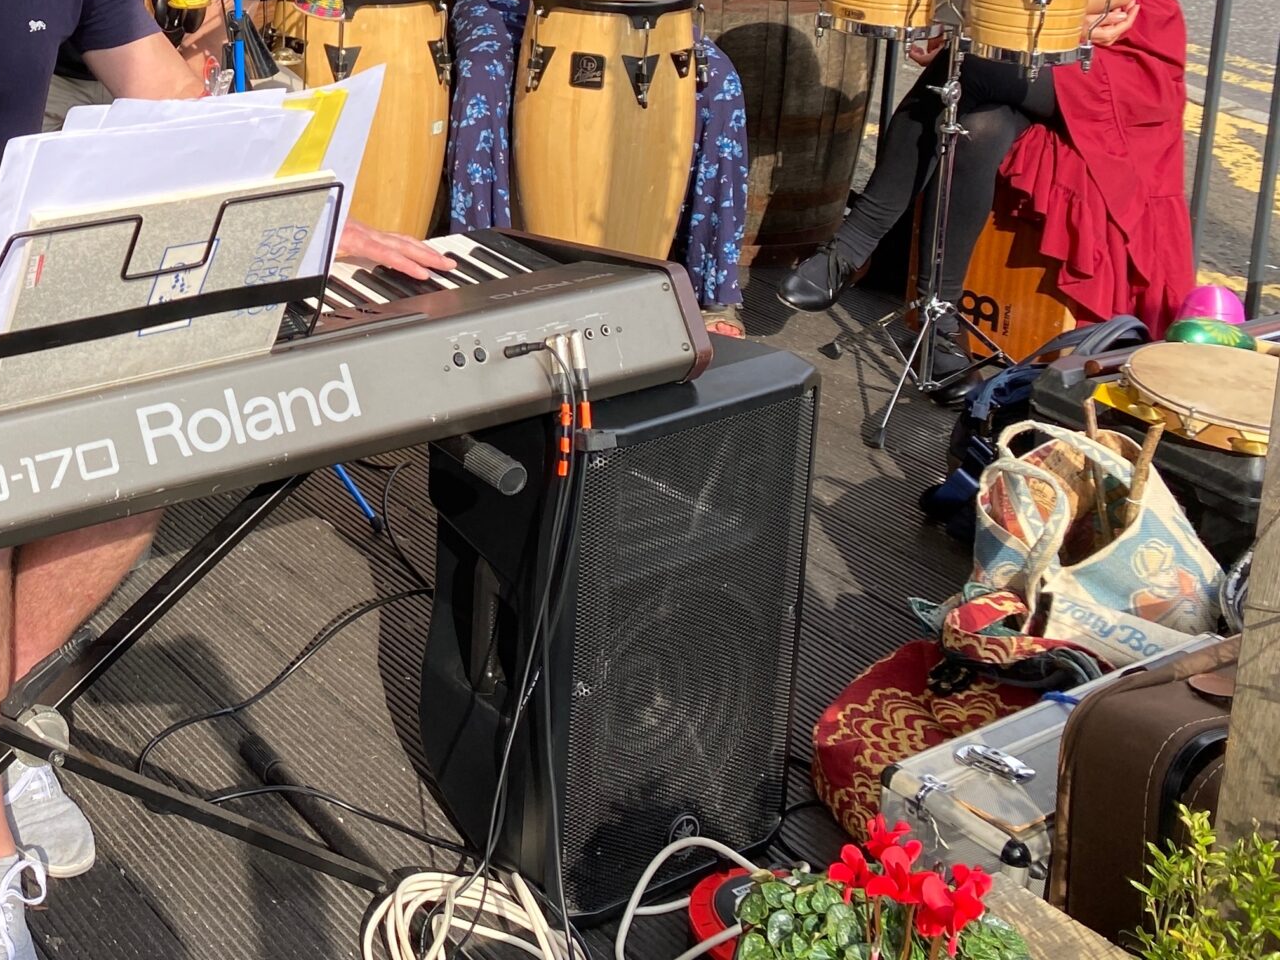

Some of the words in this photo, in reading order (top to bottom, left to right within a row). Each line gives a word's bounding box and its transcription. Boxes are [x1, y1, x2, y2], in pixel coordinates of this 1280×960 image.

[284, 225, 310, 261] JOHN
[1001, 304, 1011, 336] MEINL
[136, 363, 362, 465] Roland
